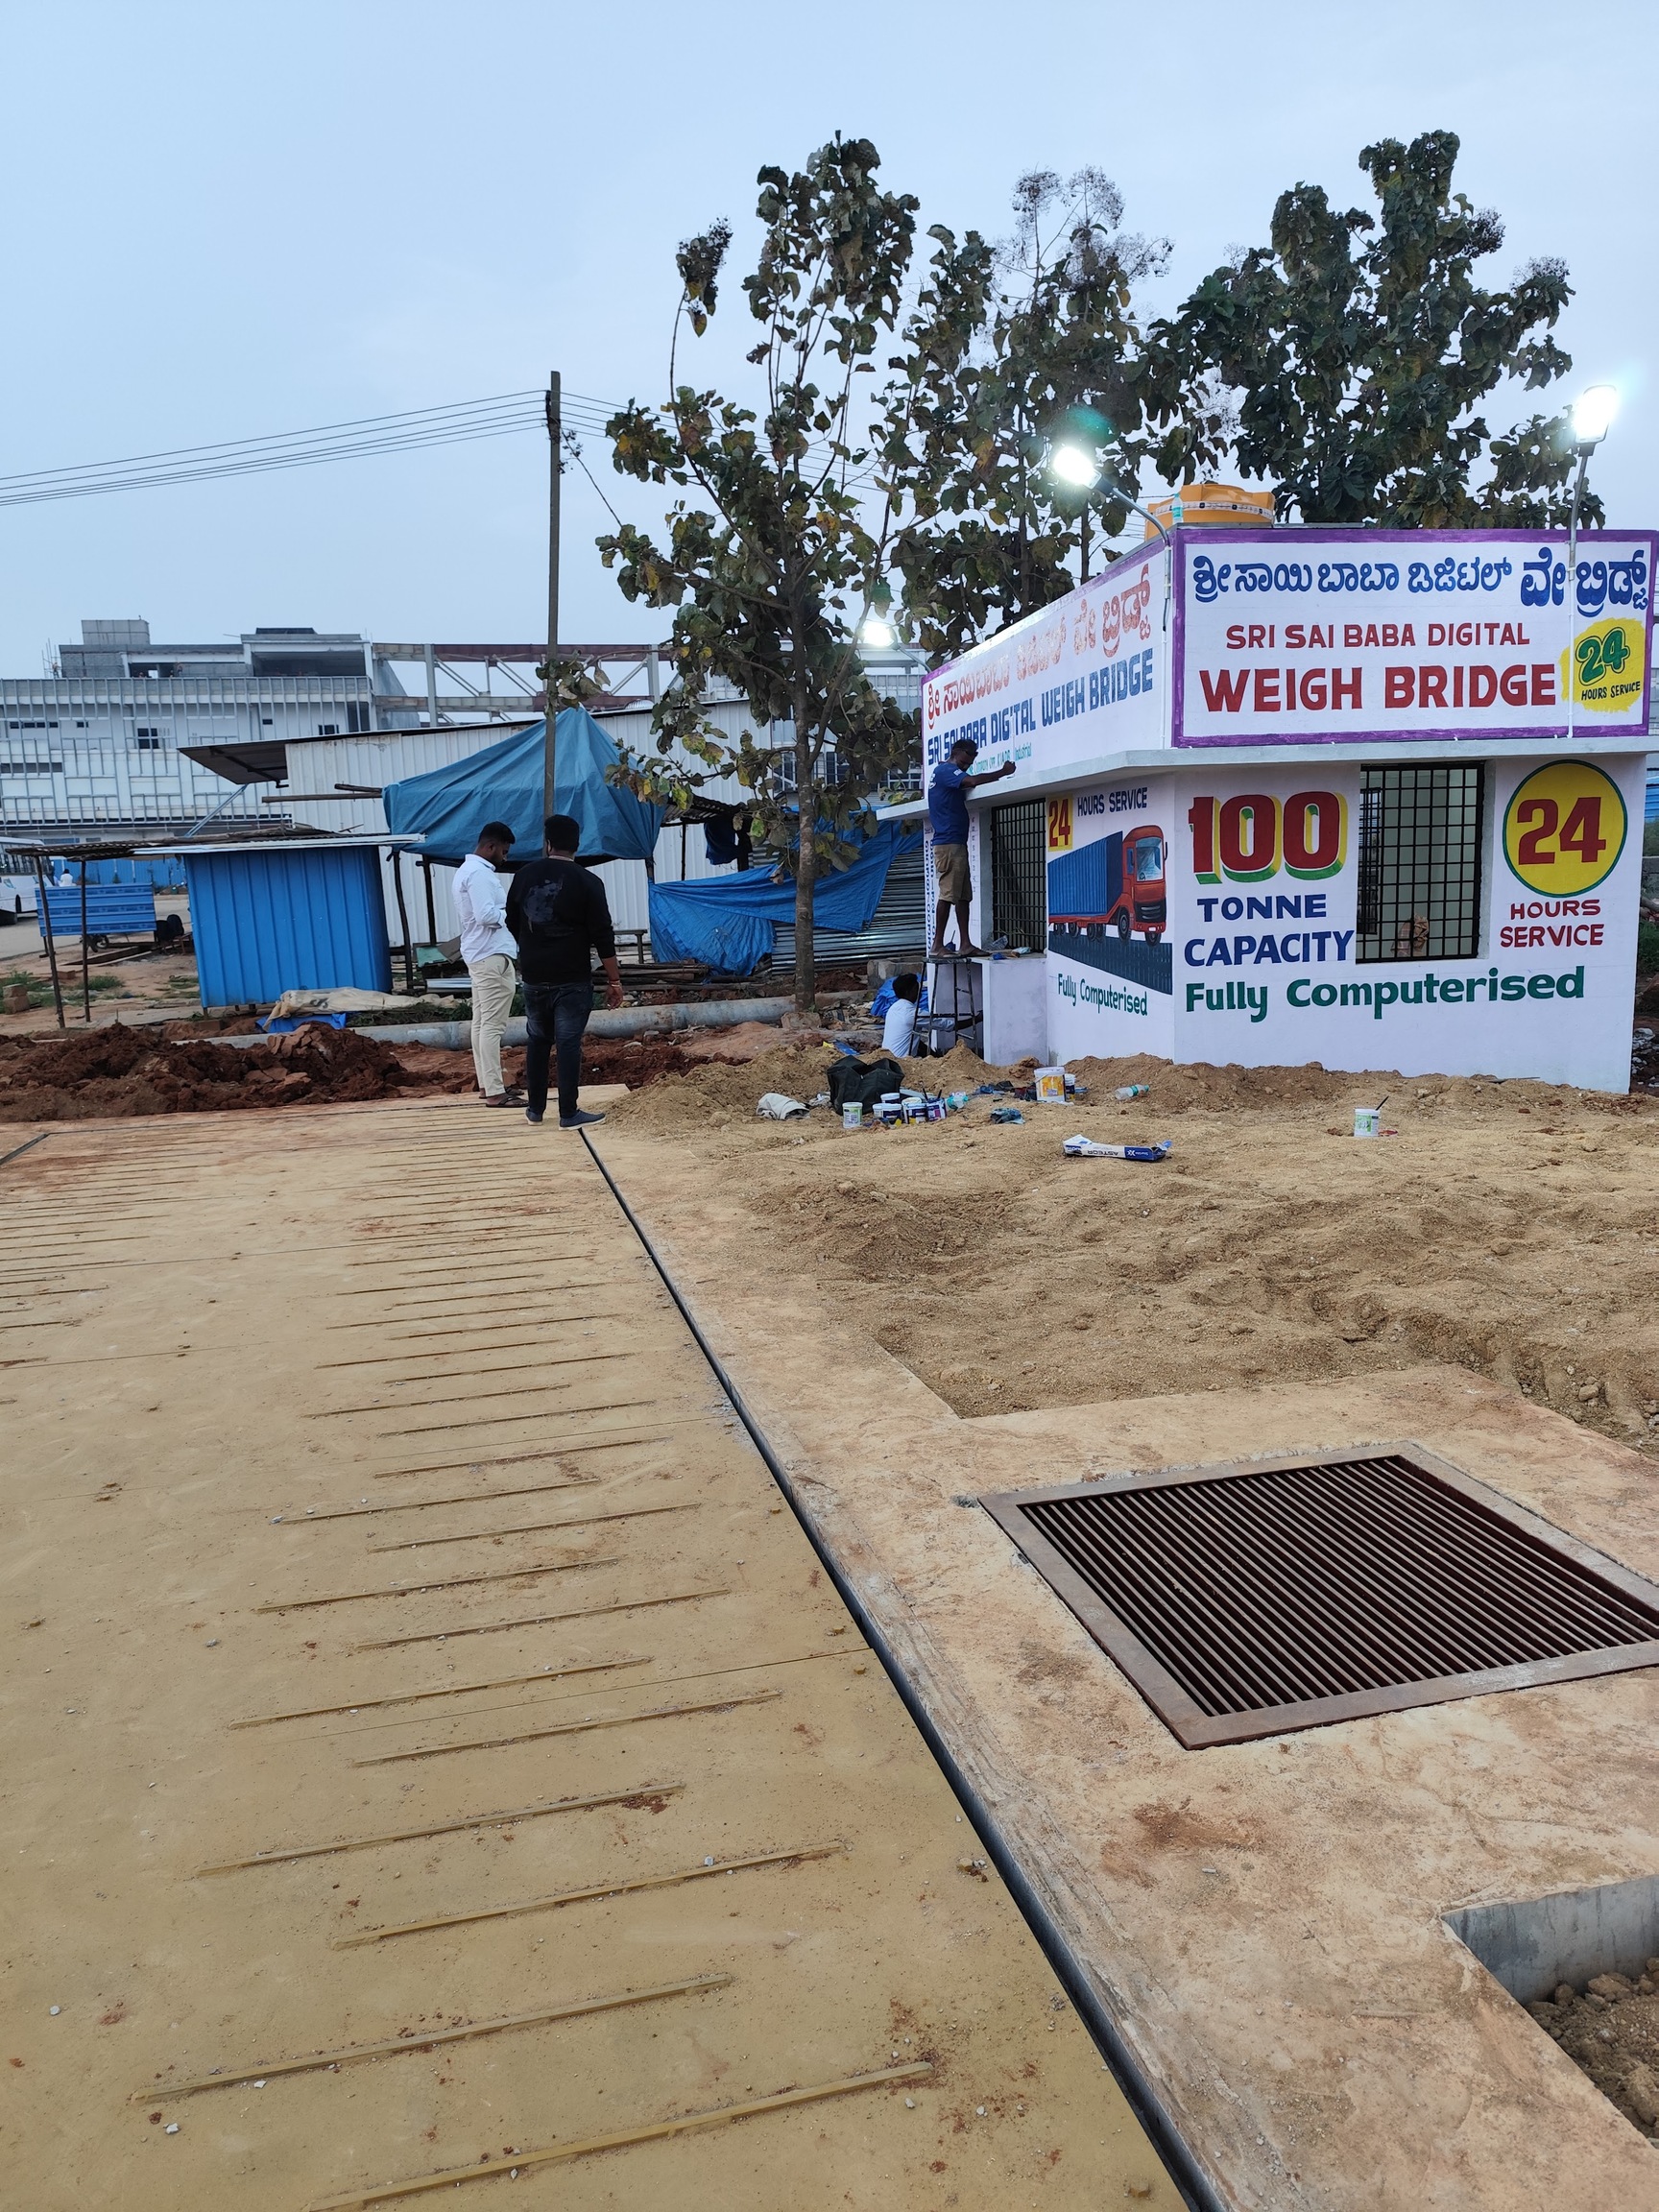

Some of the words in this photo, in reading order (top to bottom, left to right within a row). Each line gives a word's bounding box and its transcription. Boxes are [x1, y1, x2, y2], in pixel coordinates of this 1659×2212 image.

[1318, 563, 1399, 592] ಬಾಬಾ
[1226, 624, 1275, 649] SRI
[1285, 624, 1334, 649] SAI
[1344, 623, 1415, 647] BABA
[1429, 622, 1529, 646] DIGITAL
[1576, 628, 1629, 685] 24
[927, 734, 942, 766] SRI
[1042, 677, 1085, 727] WEIGH
[1090, 648, 1153, 710] BRIDGE
[1199, 666, 1362, 712] WEIGH
[1384, 663, 1556, 709] BRIDGE
[1581, 686, 1607, 701] HOURS
[1610, 681, 1641, 698] SERVICE
[1048, 798, 1070, 848] 24
[1077, 794, 1104, 817] HOURS
[1109, 787, 1148, 813] SERVICE
[1188, 790, 1348, 884] 100
[1517, 797, 1606, 864] 24
[1197, 894, 1327, 923] TONNE
[1510, 900, 1601, 920] HOURS
[1184, 929, 1355, 967] CAPACITY
[1500, 924, 1604, 949] SERVICE
[1058, 974, 1076, 1006] Fully
[1079, 978, 1148, 1017] Computerised
[1186, 982, 1267, 1022] Fully
[1286, 965, 1585, 1020] Computerised
